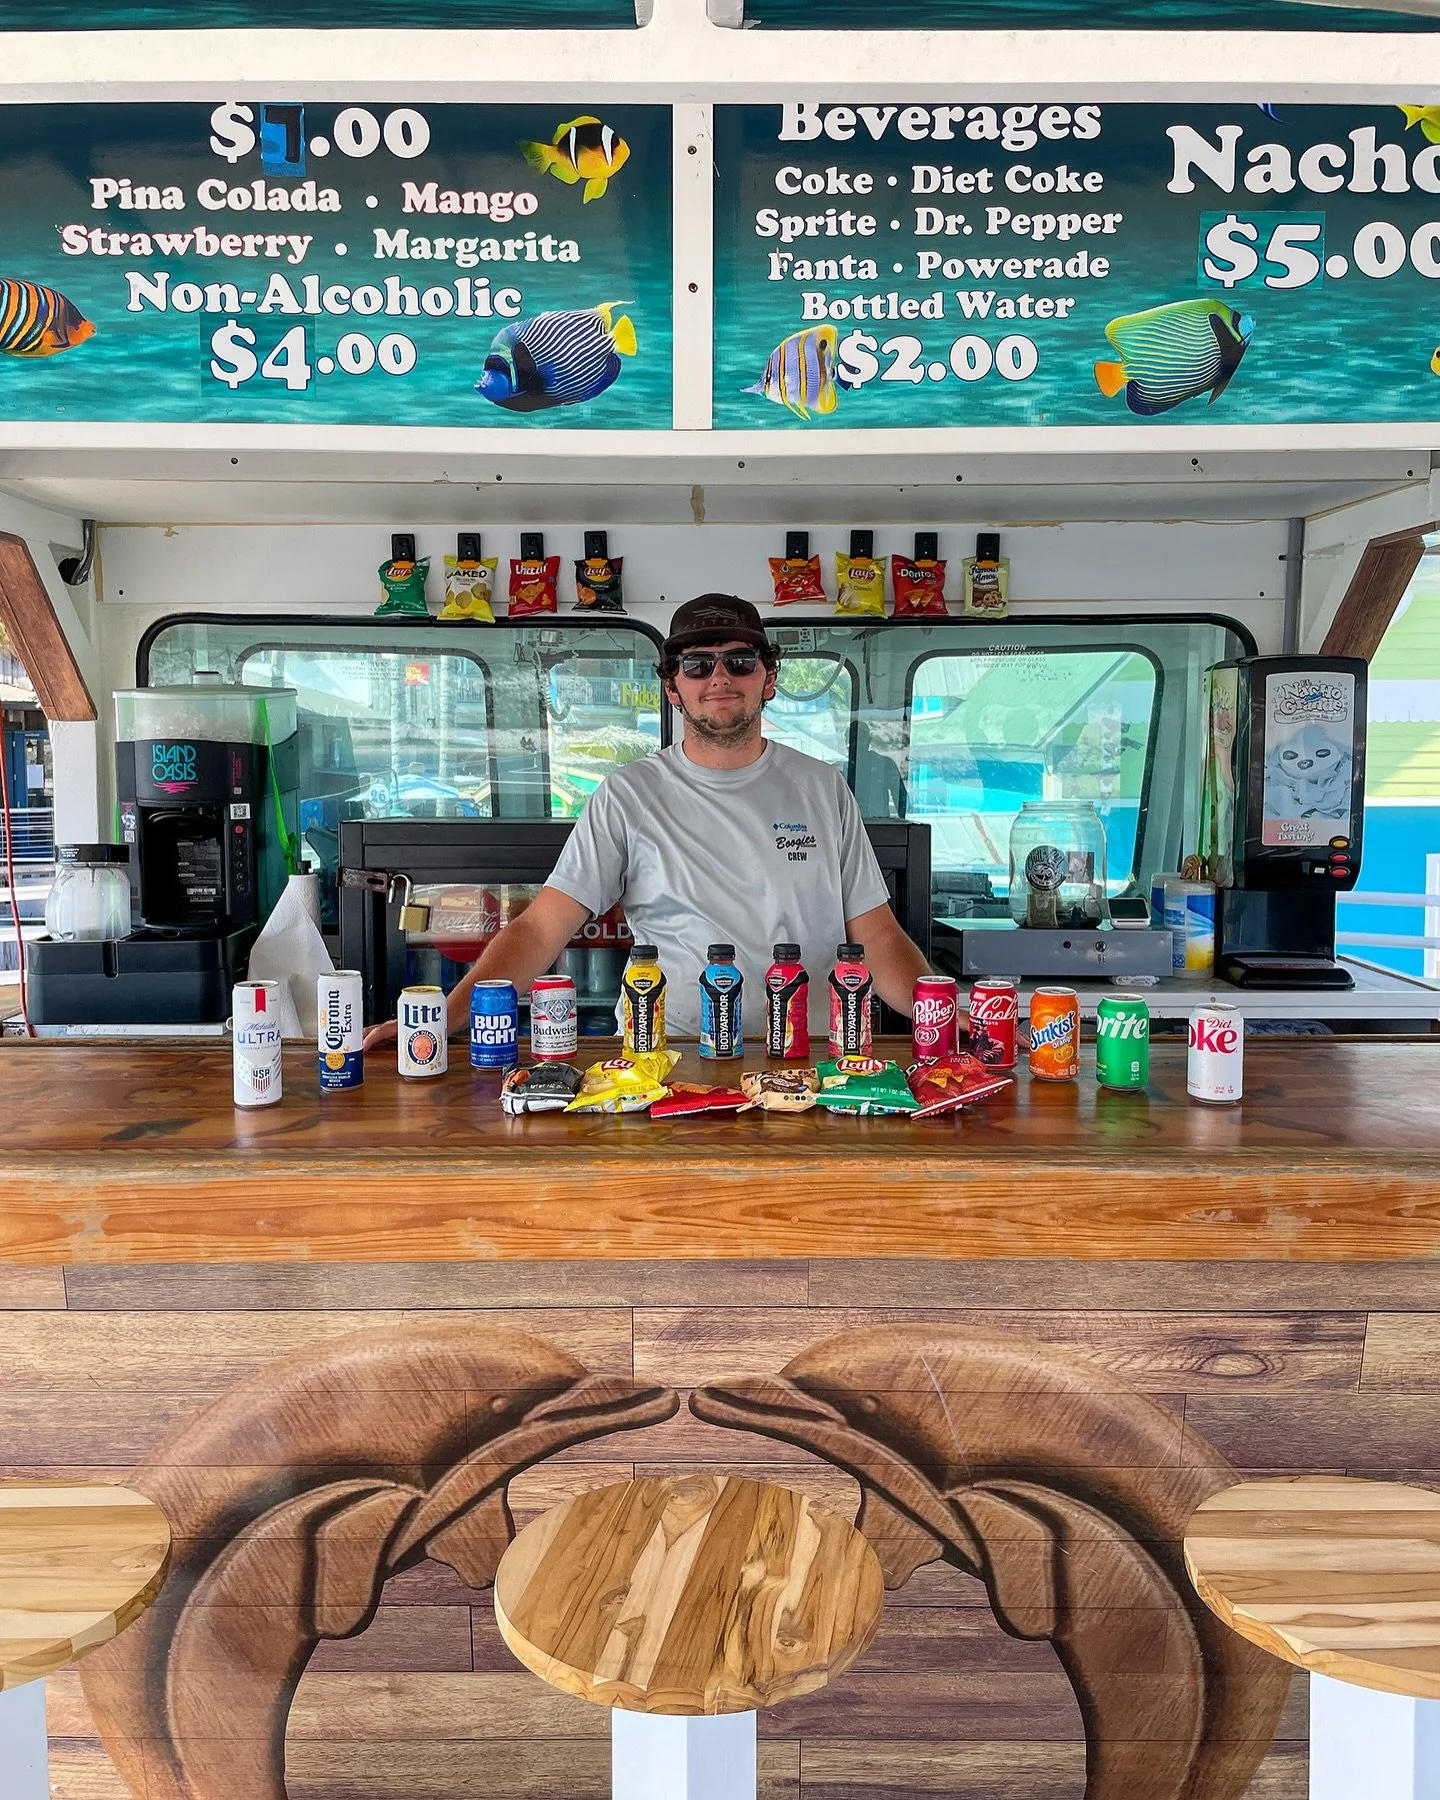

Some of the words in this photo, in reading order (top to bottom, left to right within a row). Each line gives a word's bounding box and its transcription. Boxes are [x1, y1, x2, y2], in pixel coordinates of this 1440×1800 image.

[777, 103, 1102, 152] Beverages
[775, 166, 874, 195] Coke
[910, 165, 994, 194] Diet
[1004, 164, 1104, 194] Coke
[89, 177, 186, 210] Pina
[196, 178, 342, 213] Colada
[401, 181, 539, 223] Mango
[754, 208, 877, 243] Sprite
[913, 207, 973, 236] Dr.
[984, 206, 1124, 241] Pepper
[60, 223, 314, 265] Strawberry
[372, 228, 581, 267] Margarita
[1203, 214, 1440, 289] $5.00
[767, 252, 879, 281] Fanta
[916, 251, 1110, 280] Powerade
[124, 271, 523, 318] Non-Alcoholic
[801, 291, 945, 320] Bottled
[955, 290, 1076, 319] Water
[210, 319, 418, 390] $4.00
[836, 329, 1039, 389] $2.00
[988, 644, 1027, 652] CAUTION
[1280, 698, 1343, 715] Grande
[152, 744, 196, 763] ISLAND
[152, 763, 197, 782] OASIS
[1281, 822, 1310, 832] Great
[775, 835, 816, 850] Boogies
[788, 852, 807, 861] CREW
[572, 922, 632, 940] OLD
[326, 990, 343, 1050] Corona
[341, 1004, 352, 1033] Extra
[403, 1003, 441, 1029] Lite
[915, 1001, 953, 1026] Pepper
[925, 998, 943, 1013] Dr
[474, 1015, 512, 1029] BUD
[638, 996, 648, 1052] BODYARMOR
[719, 995, 729, 1050] BODYARMOR
[772, 993, 780, 1050] BODYARMOR
[847, 993, 856, 1049] BODYARMOR
[920, 1031, 930, 1040] 23
[1030, 1011, 1075, 1052] Sunkist
[1097, 1011, 1148, 1039] rite
[1206, 1017, 1232, 1029] Diet
[237, 1029, 281, 1044] ULTRA
[471, 1028, 516, 1044] LIGHT
[1188, 1018, 1238, 1054] ke
[252, 1068, 270, 1079] USA
